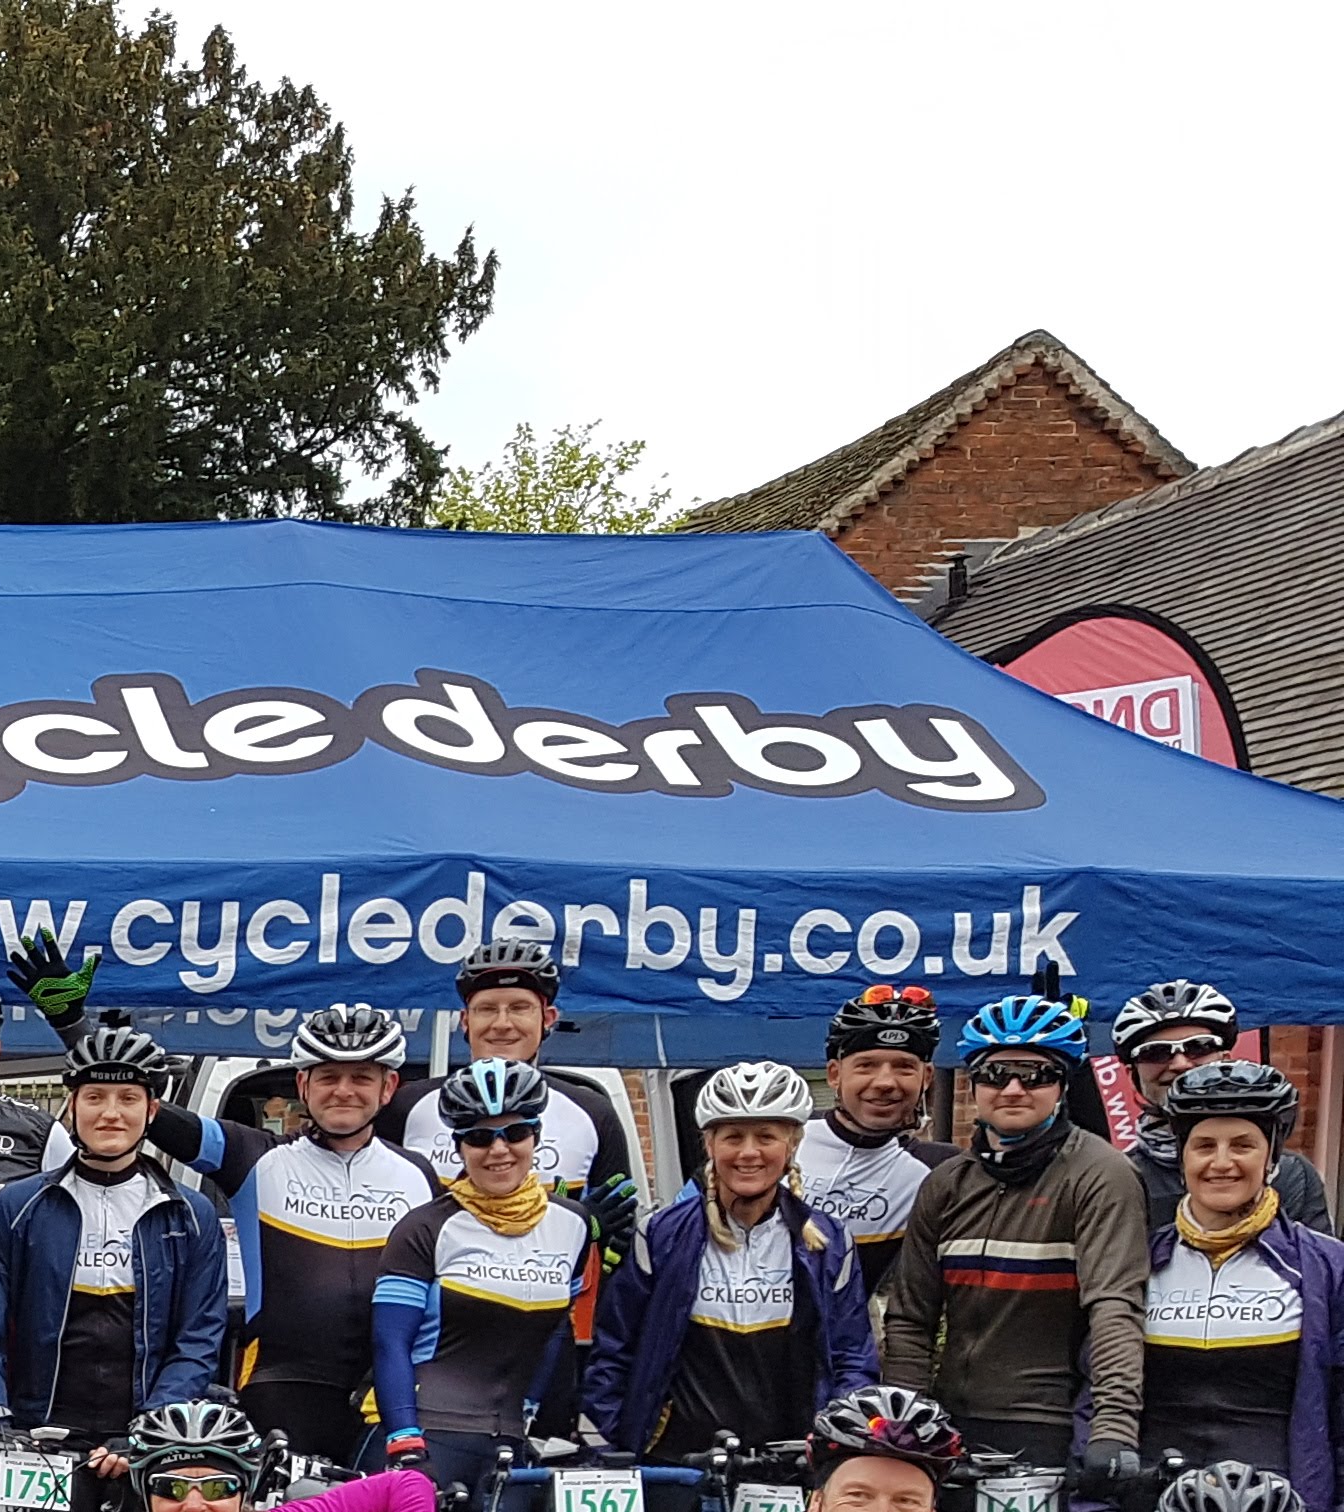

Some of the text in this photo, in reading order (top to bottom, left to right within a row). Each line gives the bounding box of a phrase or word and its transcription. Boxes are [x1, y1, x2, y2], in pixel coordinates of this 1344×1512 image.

[286, 1179, 342, 1202] CYCLE
[284, 1196, 397, 1222] MICKLEOVER
[466, 1265, 563, 1285] MICKLEOVER
[4, 1468, 69, 1504] 1758
